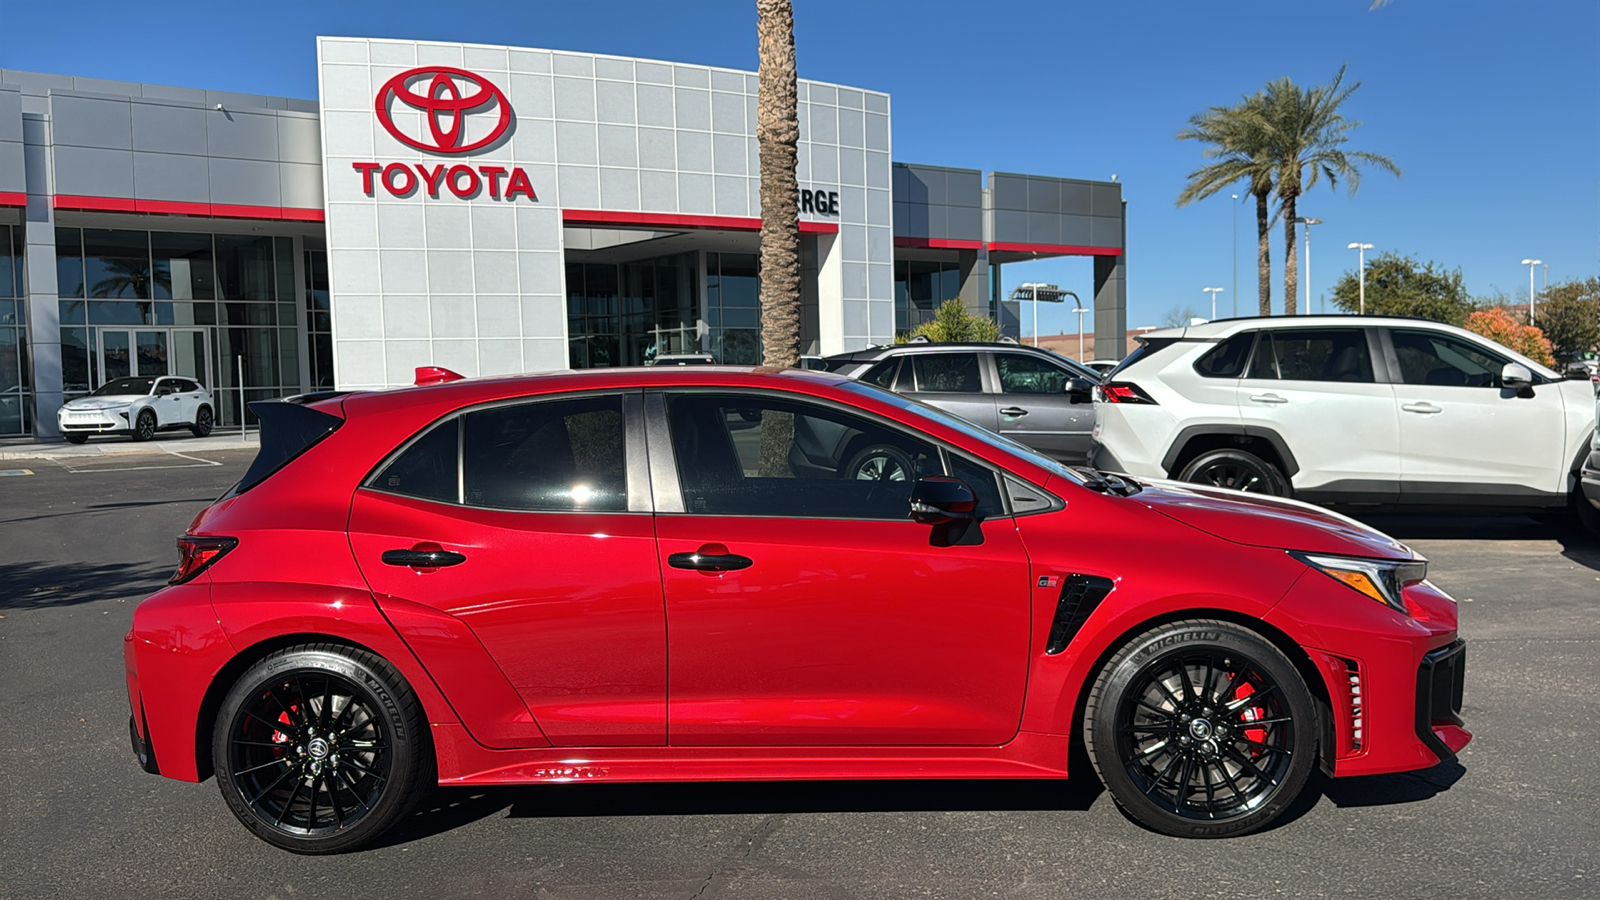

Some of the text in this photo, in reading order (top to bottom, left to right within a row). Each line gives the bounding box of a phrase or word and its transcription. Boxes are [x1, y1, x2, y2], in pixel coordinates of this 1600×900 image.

[352, 162, 536, 198] TOYOTA
[1148, 632, 1217, 651] MICHELIN
[368, 679, 405, 737] MICHELIN
